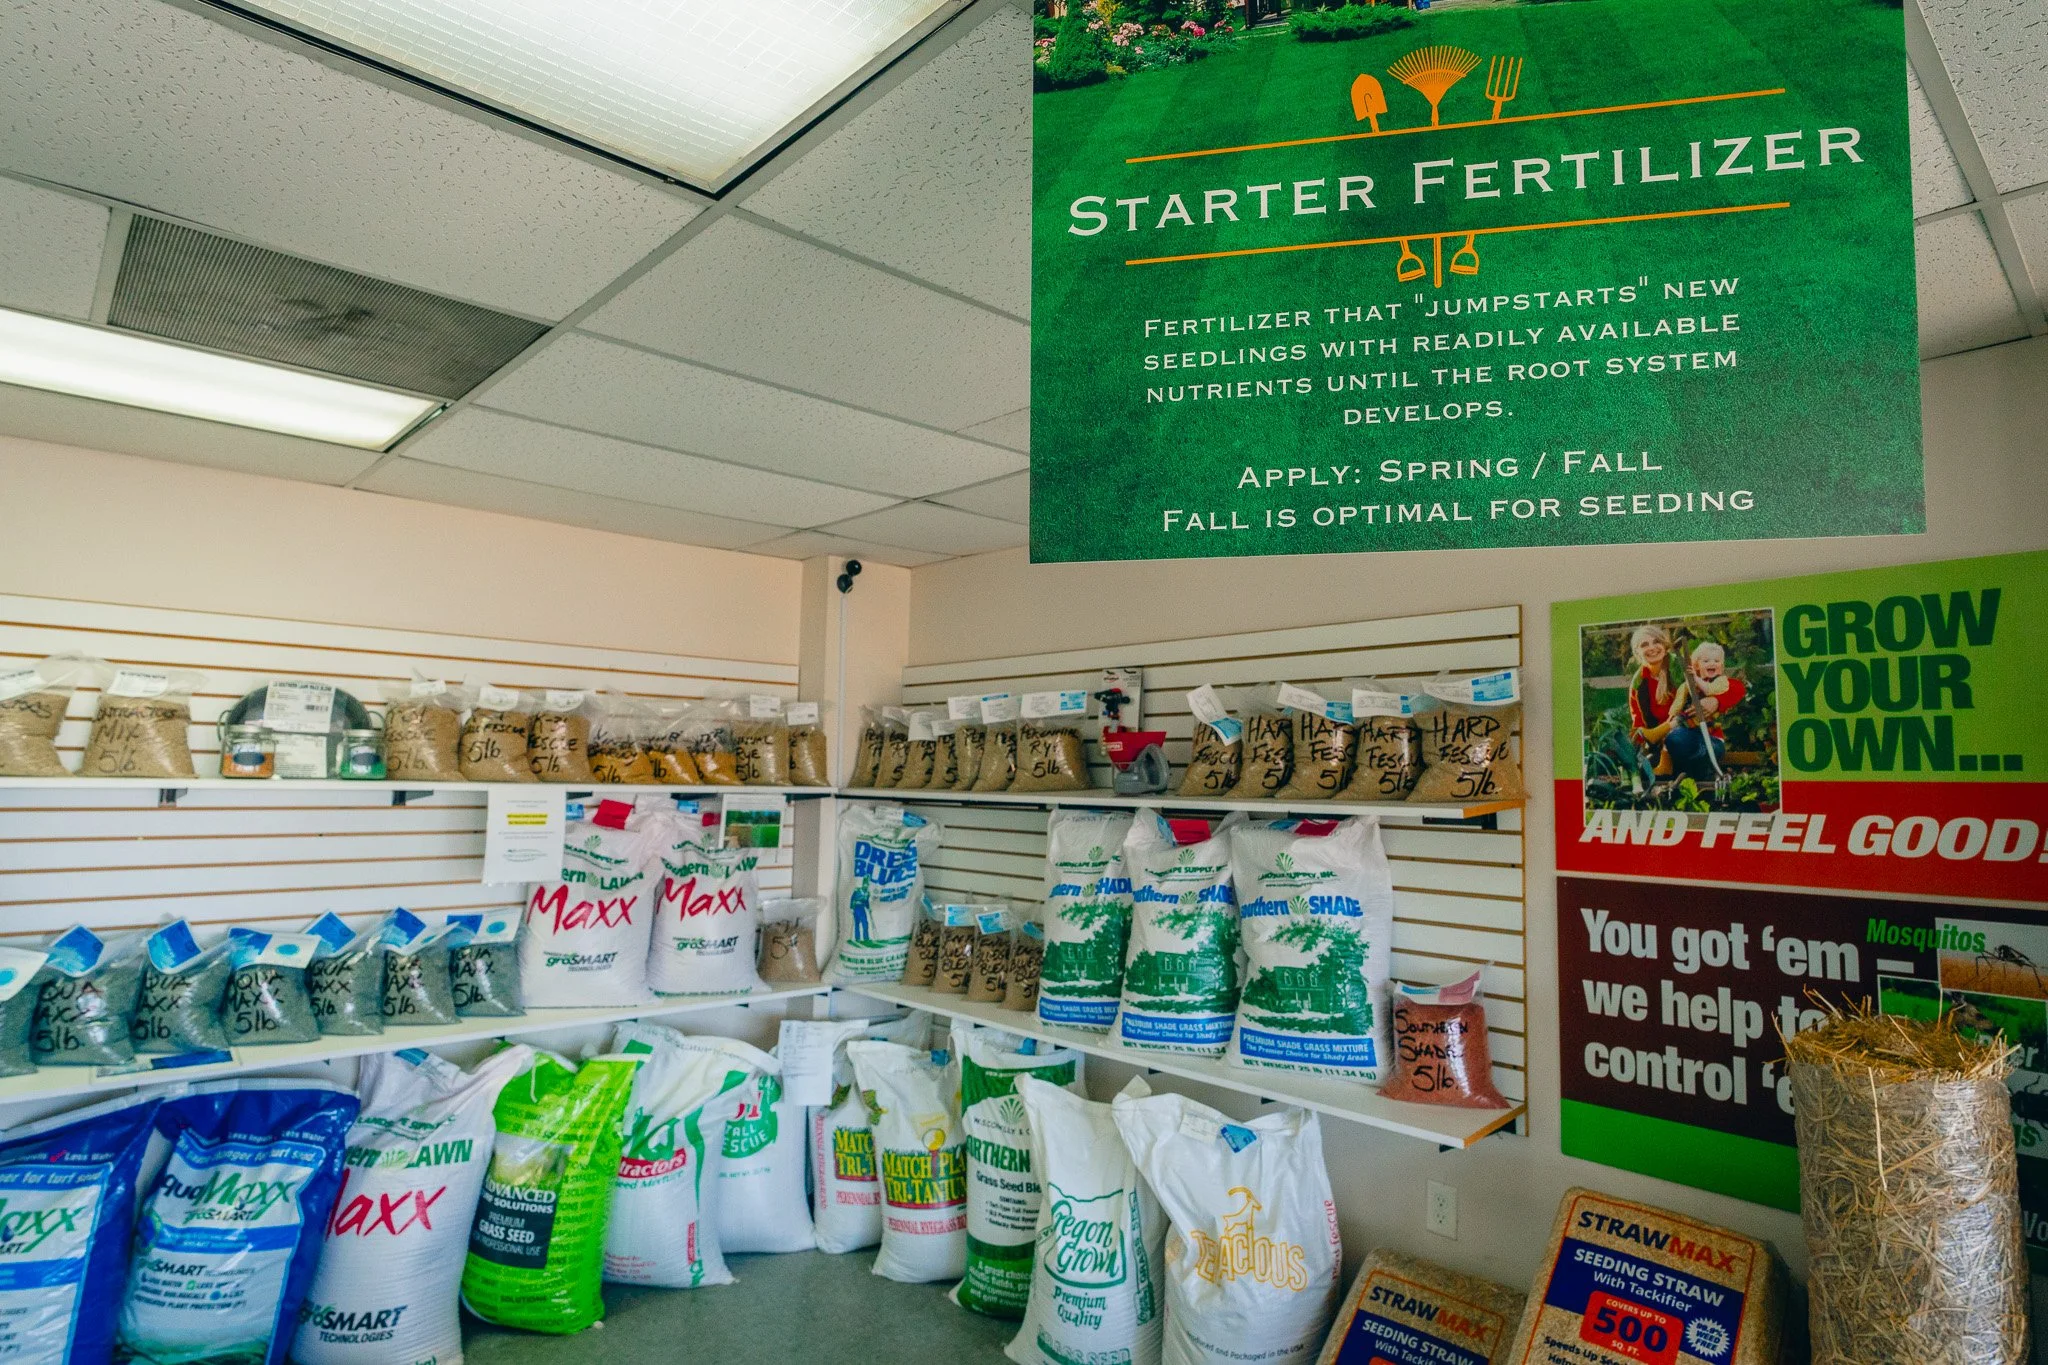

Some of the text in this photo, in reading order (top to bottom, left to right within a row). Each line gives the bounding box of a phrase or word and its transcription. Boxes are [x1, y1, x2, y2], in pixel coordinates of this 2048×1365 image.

[1068, 126, 1865, 237] STARTER FERTILIZER
[1144, 276, 1740, 338] FERTILIZER THAT "JUMPSTARTS" NEW
[1144, 314, 1740, 371] SEEDLINGS WITH READILY AVAILABLE
[1147, 351, 1737, 403] NUTRIENTS UNTIL THE ROOT SYSTEM
[1344, 401, 1513, 425] DEVELOPS.
[1237, 450, 1662, 489] APPLY: SPRING / FALL
[1163, 490, 1755, 532] FALL IS OPTIMAL FOR SEEDING
[1781, 587, 2001, 659] GROW
[1781, 654, 1975, 714] YOUR
[1427, 711, 1500, 747] HARD
[1786, 715, 2023, 772] OWN...
[1579, 808, 1688, 846] AND
[1701, 812, 1836, 854] FEEL
[1095, 877, 1133, 895] SHAD
[1309, 895, 1363, 917] SHADE
[1580, 908, 1658, 959] You
[1671, 923, 1750, 974] got
[1866, 918, 1986, 952] Mosquitos
[1178, 1023, 1203, 1031] GRASS
[1582, 979, 1648, 1021] we
[1660, 980, 1764, 1049] help
[1244, 1033, 1368, 1053] PREMIUM SHADE GRASS MIXTURE
[1247, 1043, 1257, 1051] The
[1258, 1046, 1283, 1055] Premier
[1286, 1048, 1309, 1057] Choice
[1323, 1052, 1345, 1062] Shady
[1584, 1041, 1748, 1106] control
[836, 1130, 874, 1153] MATC
[966, 1135, 1031, 1173] ORTHERN
[619, 1154, 686, 1177] tractors
[883, 1151, 967, 1178] MATCH PLA
[976, 1171, 1023, 1192] Grass Seed
[494, 1197, 554, 1214] SOLUTIONS
[479, 1219, 535, 1244] GRASS SEED
[1578, 1211, 1735, 1273] STRAWMAX
[1574, 1249, 1725, 1307] SEEDING STRAW
[1594, 1271, 1692, 1313] With Tackifier
[1053, 1286, 1107, 1311] Premium
[1057, 1298, 1102, 1330] Quality
[1369, 1286, 1490, 1342] STRAWMAX
[1606, 1298, 1667, 1325] COVERS UP TO
[319, 1330, 394, 1344] TECHNOLOGIES
[1363, 1319, 1418, 1349] SEEDING
[1593, 1307, 1668, 1352] 500
[1695, 1338, 1718, 1351] FREE
[1697, 1330, 1721, 1344] WEED
[1230, 1350, 1266, 1361] Packaged
[1276, 1346, 1289, 1356] the
[1375, 1339, 1400, 1357] With
[1544, 1336, 1598, 1362] Speeds Up
